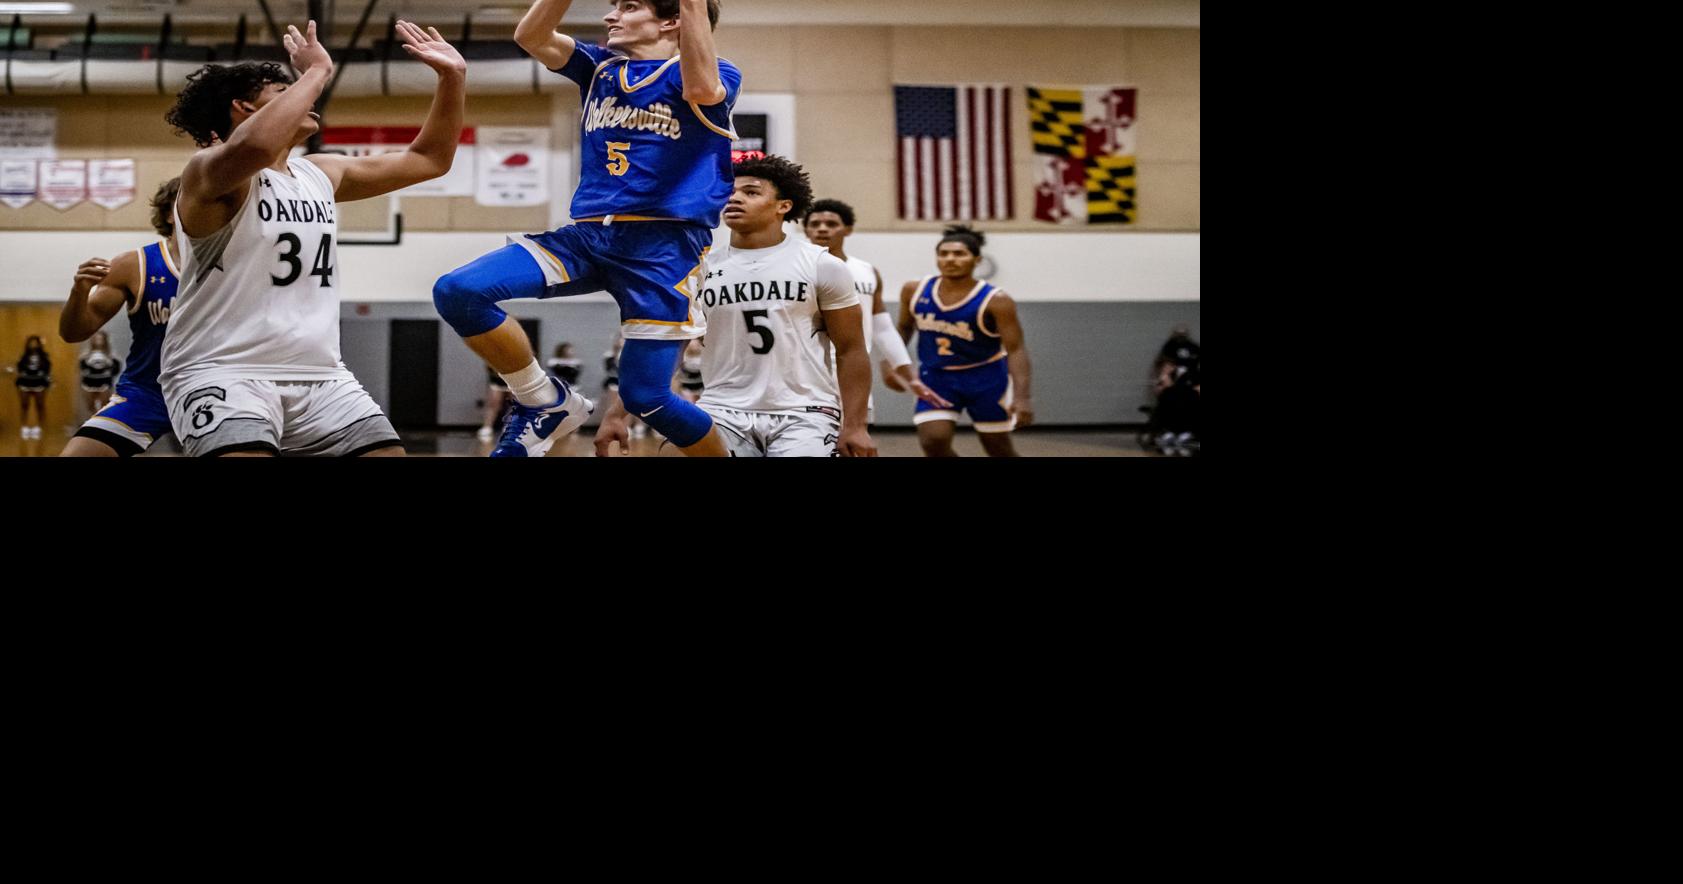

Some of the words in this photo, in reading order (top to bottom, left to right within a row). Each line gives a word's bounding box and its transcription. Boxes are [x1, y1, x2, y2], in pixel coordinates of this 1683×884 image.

[605, 141, 631, 176] 5
[270, 232, 334, 288] 34
[703, 280, 808, 308] OAKDALE
[742, 308, 775, 355] 5
[935, 337, 955, 356] 2
